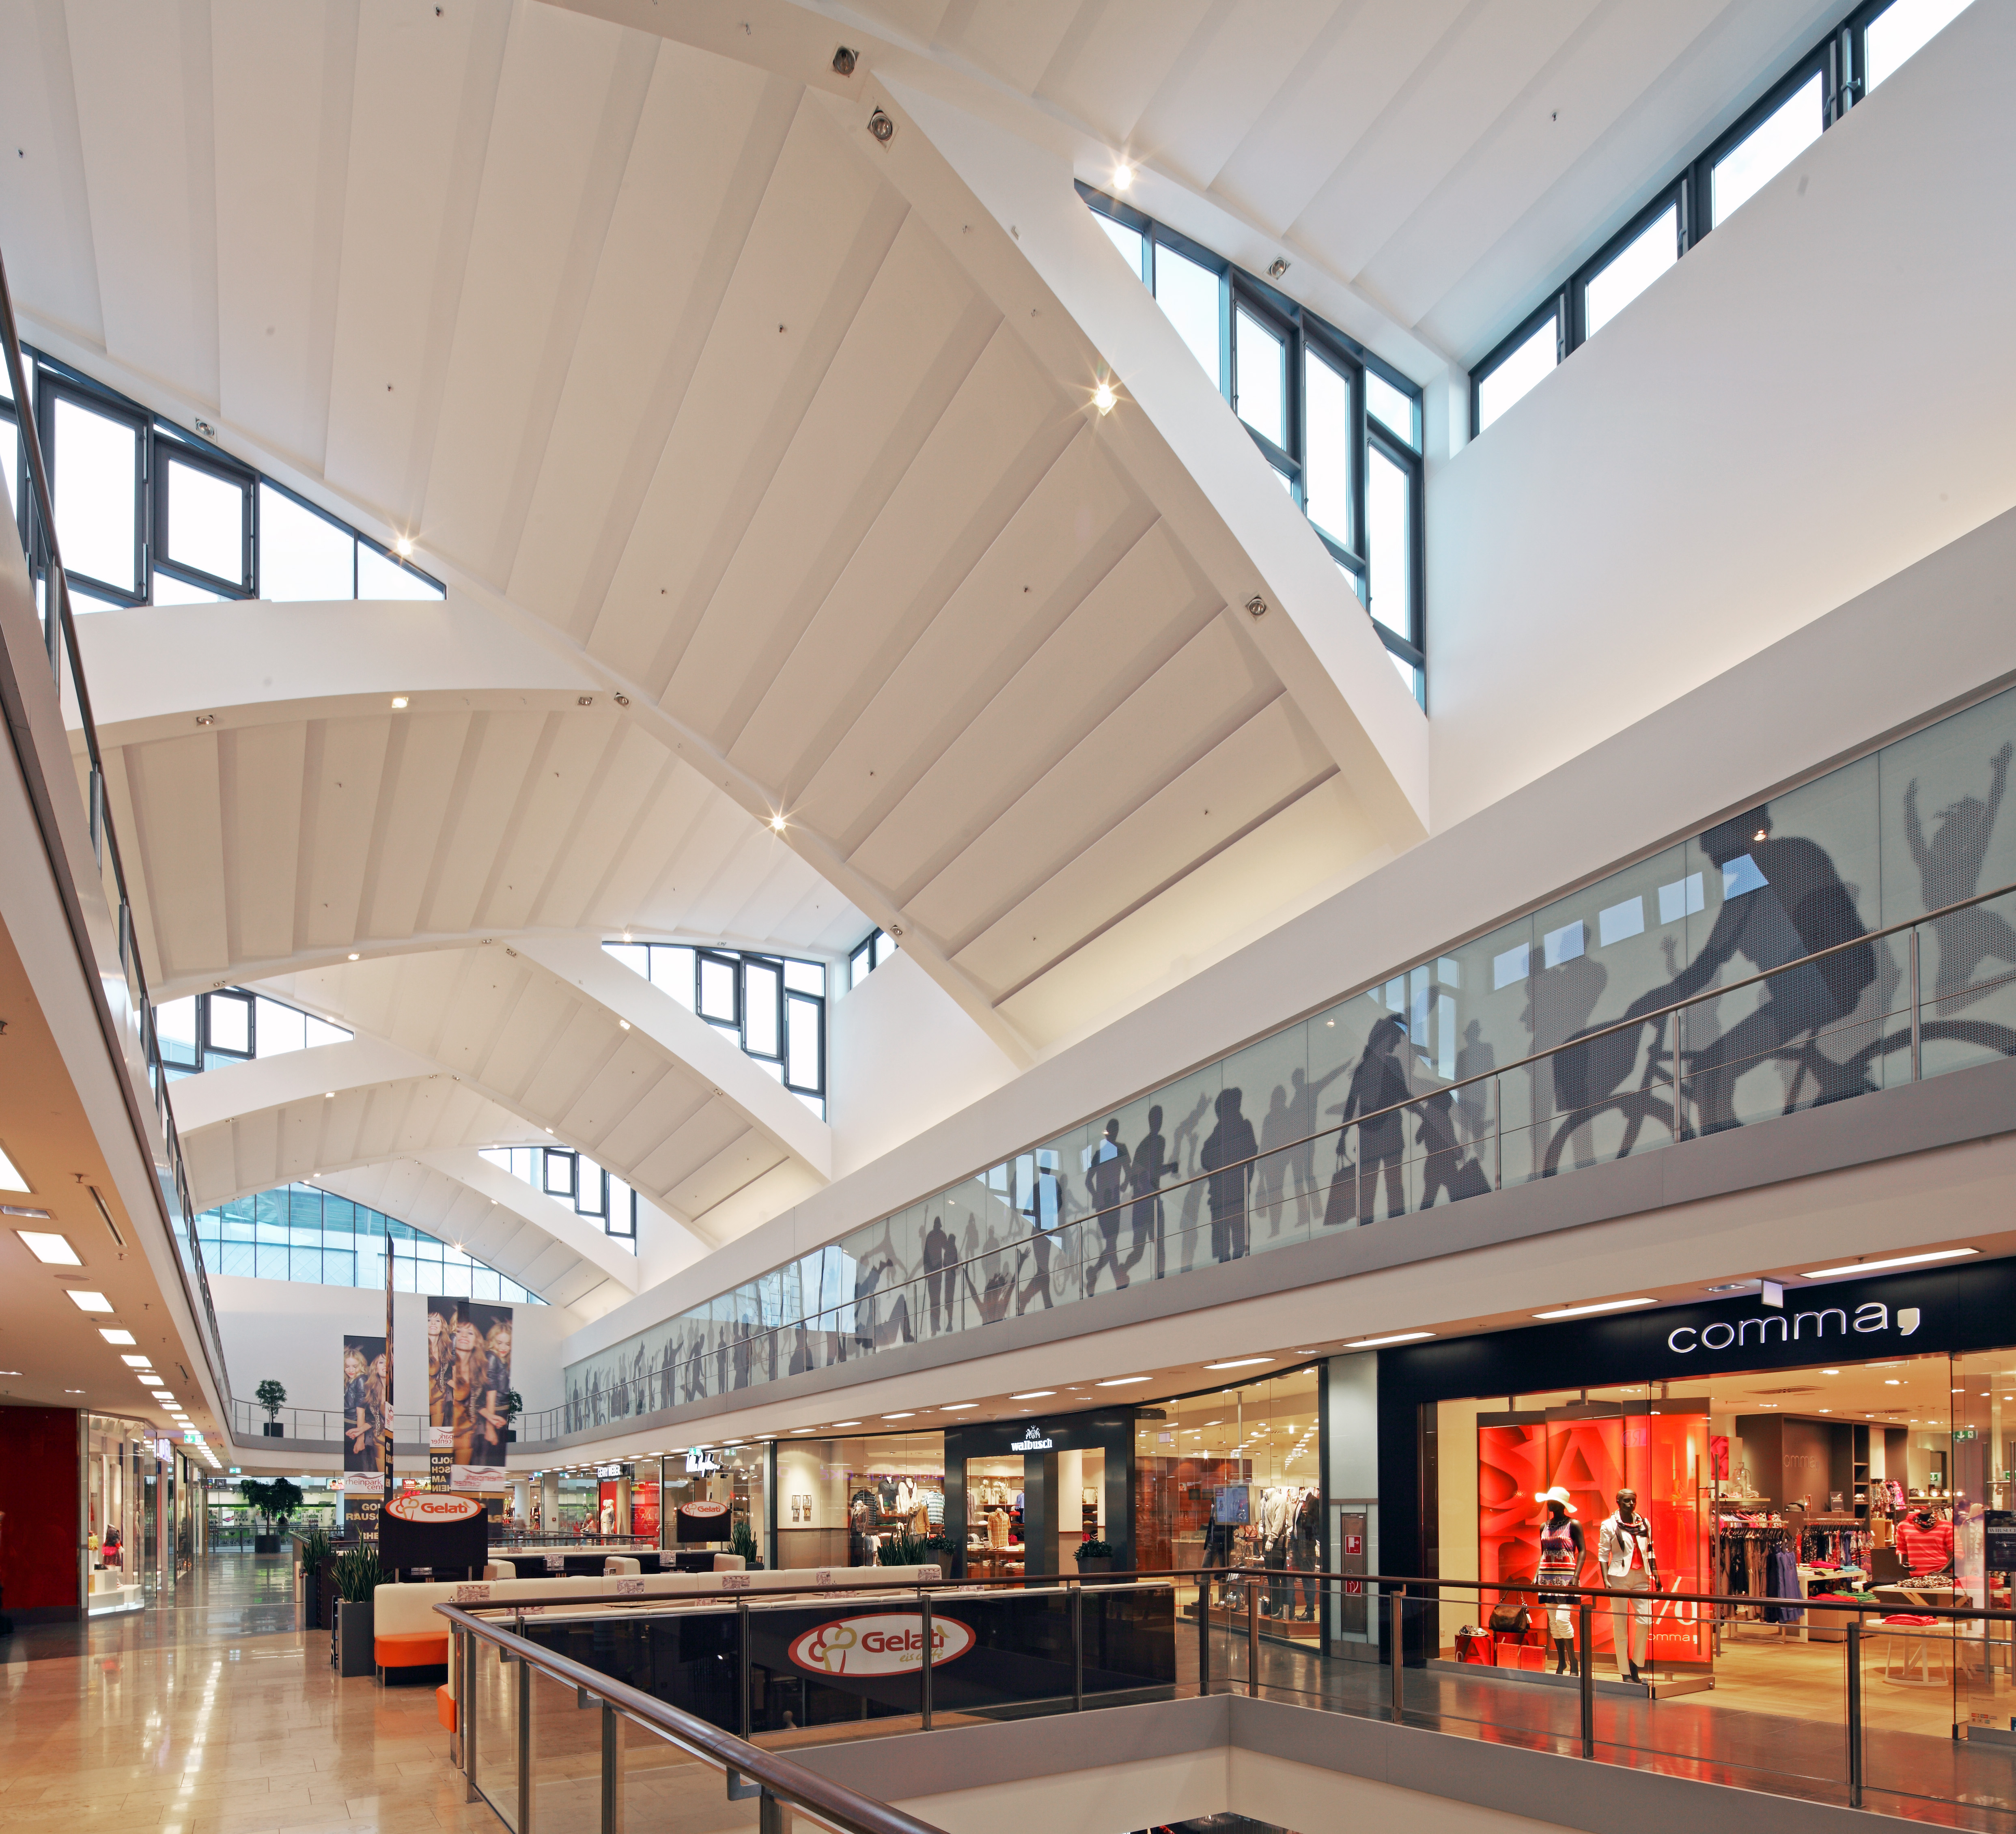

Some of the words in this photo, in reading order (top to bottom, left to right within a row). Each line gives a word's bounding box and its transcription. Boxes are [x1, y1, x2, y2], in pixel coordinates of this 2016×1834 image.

[1011, 1438, 1053, 1451] walbusch
[597, 1466, 608, 1478] GERRY
[608, 1465, 620, 1477] WEBER
[362, 1503, 381, 1511] GOL
[899, 1653, 914, 1662] eis
